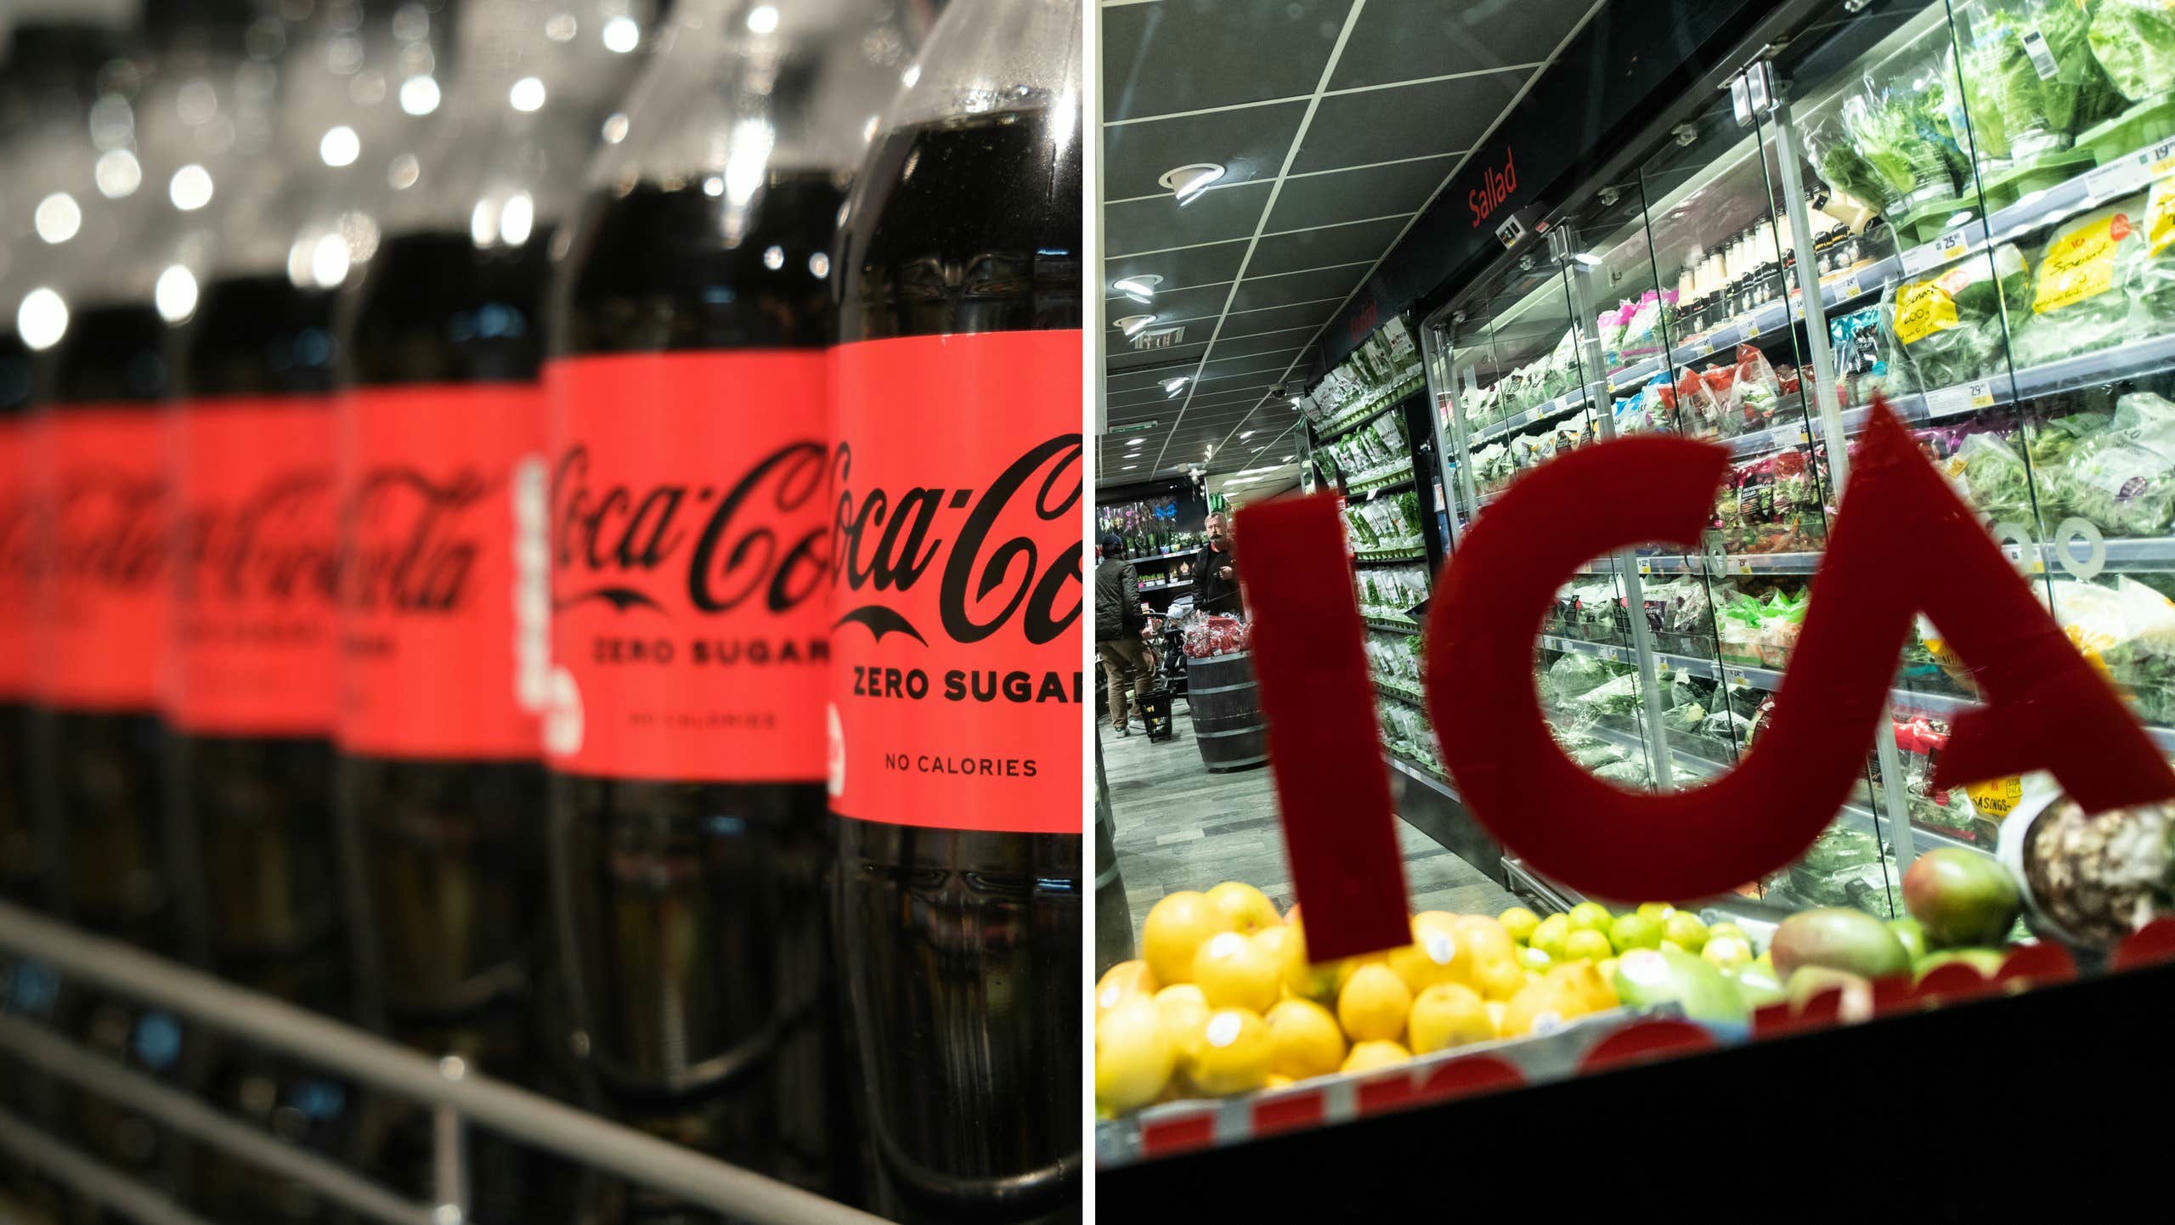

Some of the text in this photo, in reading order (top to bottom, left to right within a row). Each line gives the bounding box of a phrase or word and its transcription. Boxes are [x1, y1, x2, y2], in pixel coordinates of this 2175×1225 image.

[1468, 143, 1517, 228] Sallad
[592, 635, 675, 664] ZERO
[853, 666, 929, 700] ZERO
[1236, 397, 2175, 964] ICA
[885, 753, 1037, 777] NO CALORIES
